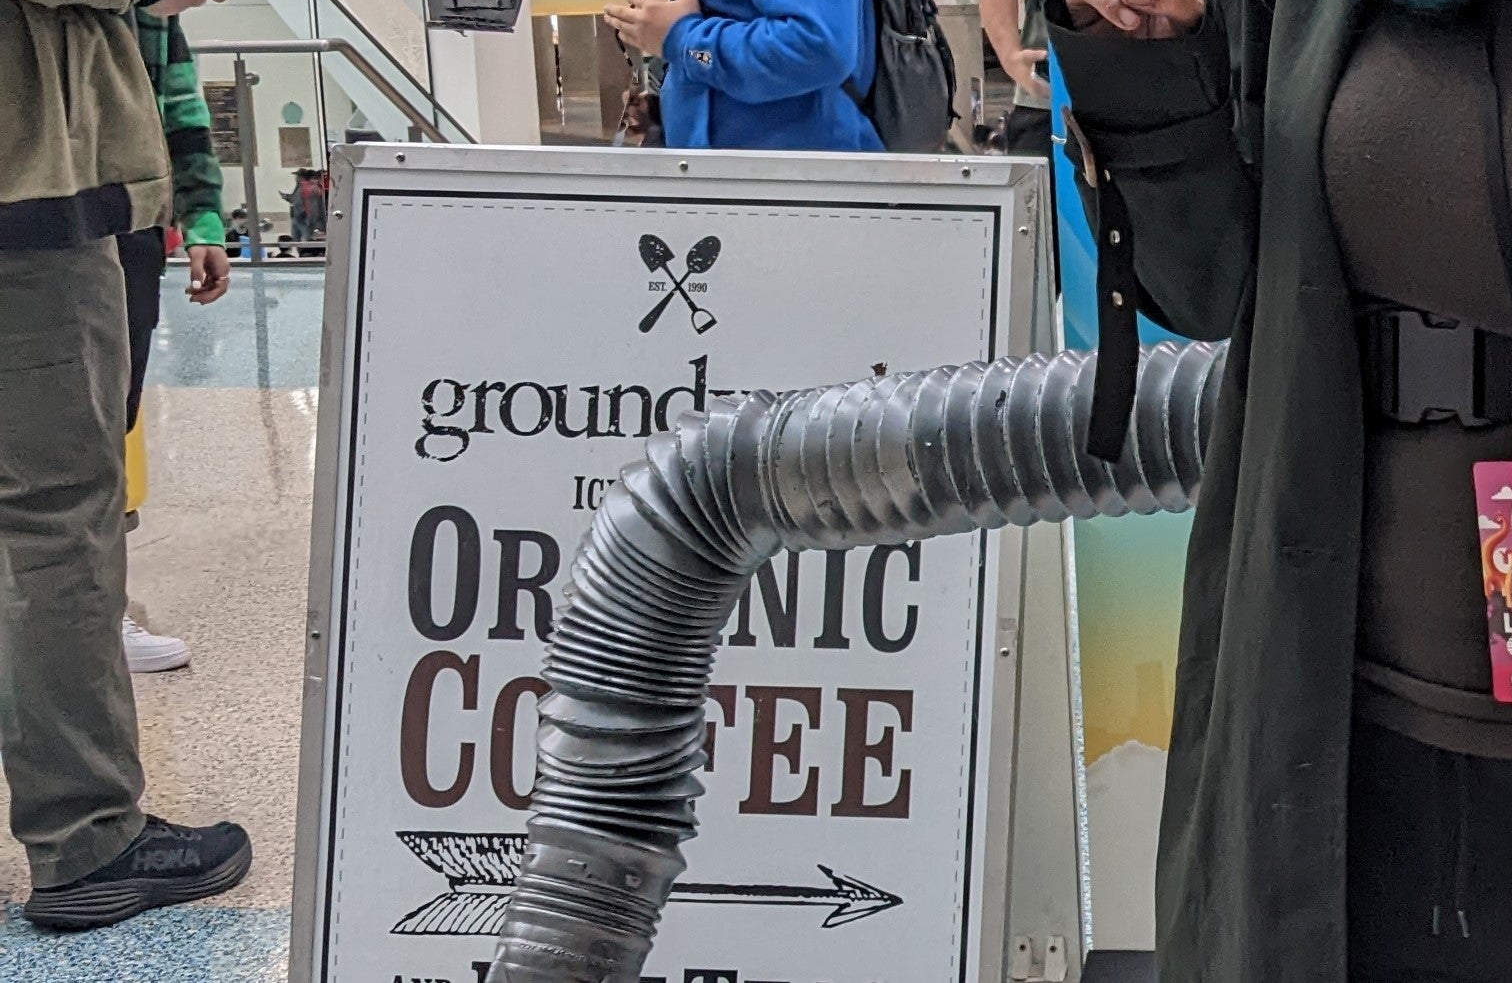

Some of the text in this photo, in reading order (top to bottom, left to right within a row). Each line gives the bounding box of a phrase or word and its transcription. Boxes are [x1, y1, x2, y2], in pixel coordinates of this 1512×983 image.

[648, 281, 708, 293] EST. 1990
[414, 354, 782, 463] ground
[573, 475, 613, 510] IC
[407, 505, 921, 654] ORNIC
[400, 649, 915, 820] COEE
[134, 848, 202, 872] HOKA
